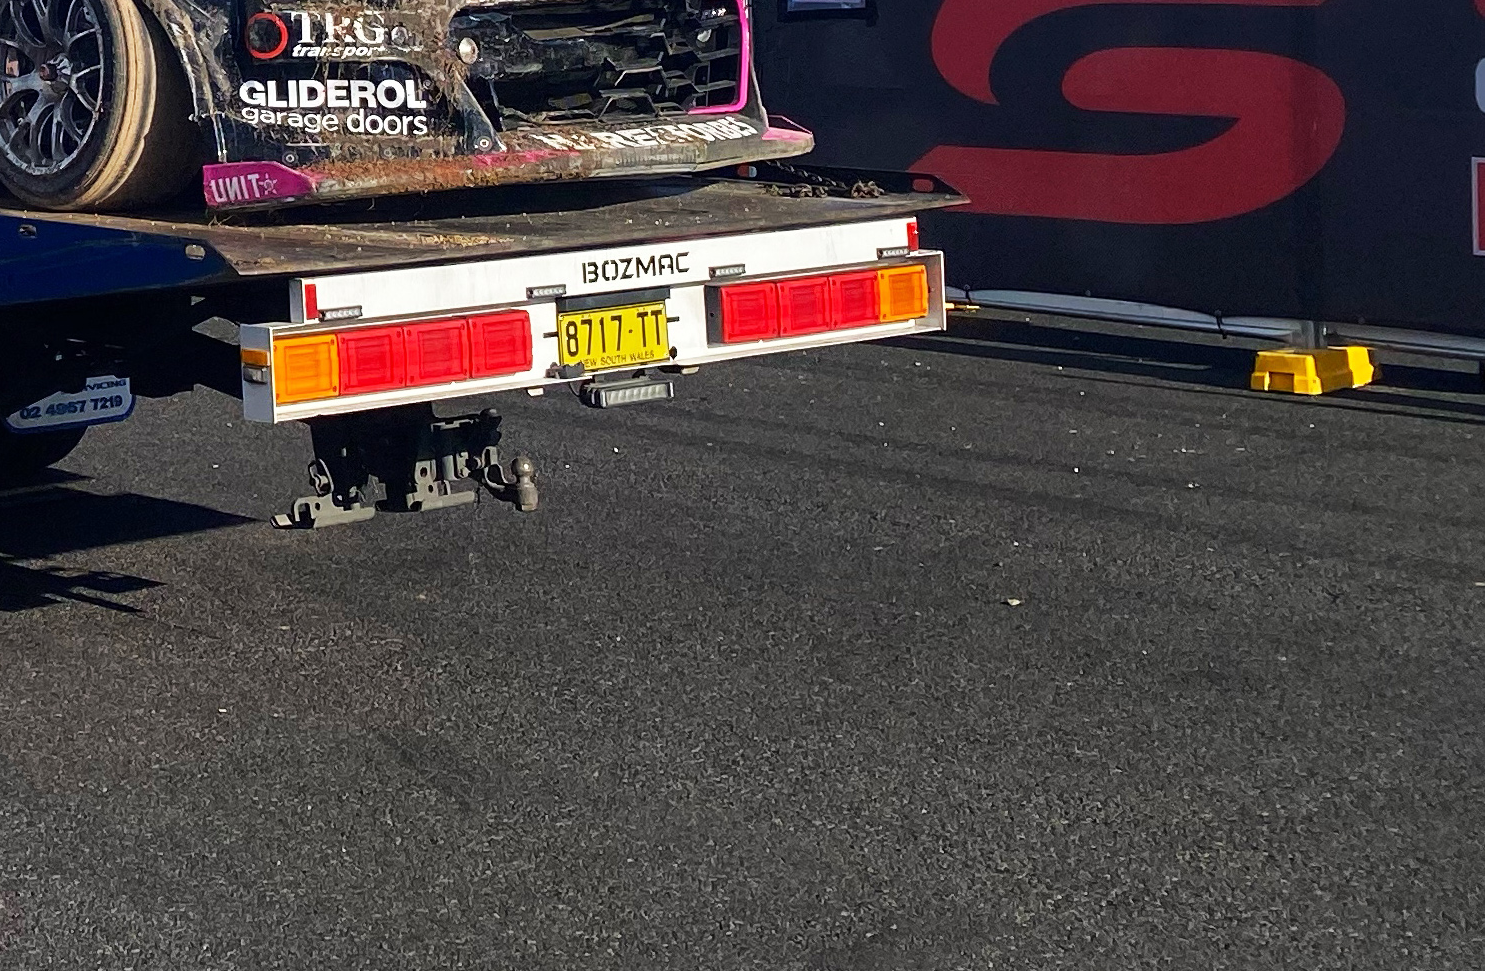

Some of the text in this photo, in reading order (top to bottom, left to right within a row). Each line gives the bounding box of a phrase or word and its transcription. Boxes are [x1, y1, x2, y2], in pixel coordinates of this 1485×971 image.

[239, 79, 427, 110] GLIDEROL
[241, 107, 427, 136] garage doors
[582, 252, 689, 283] BOZMAC
[601, 355, 627, 366] SOUTH
[630, 350, 655, 361] WALES
[20, 407, 41, 419] 02
